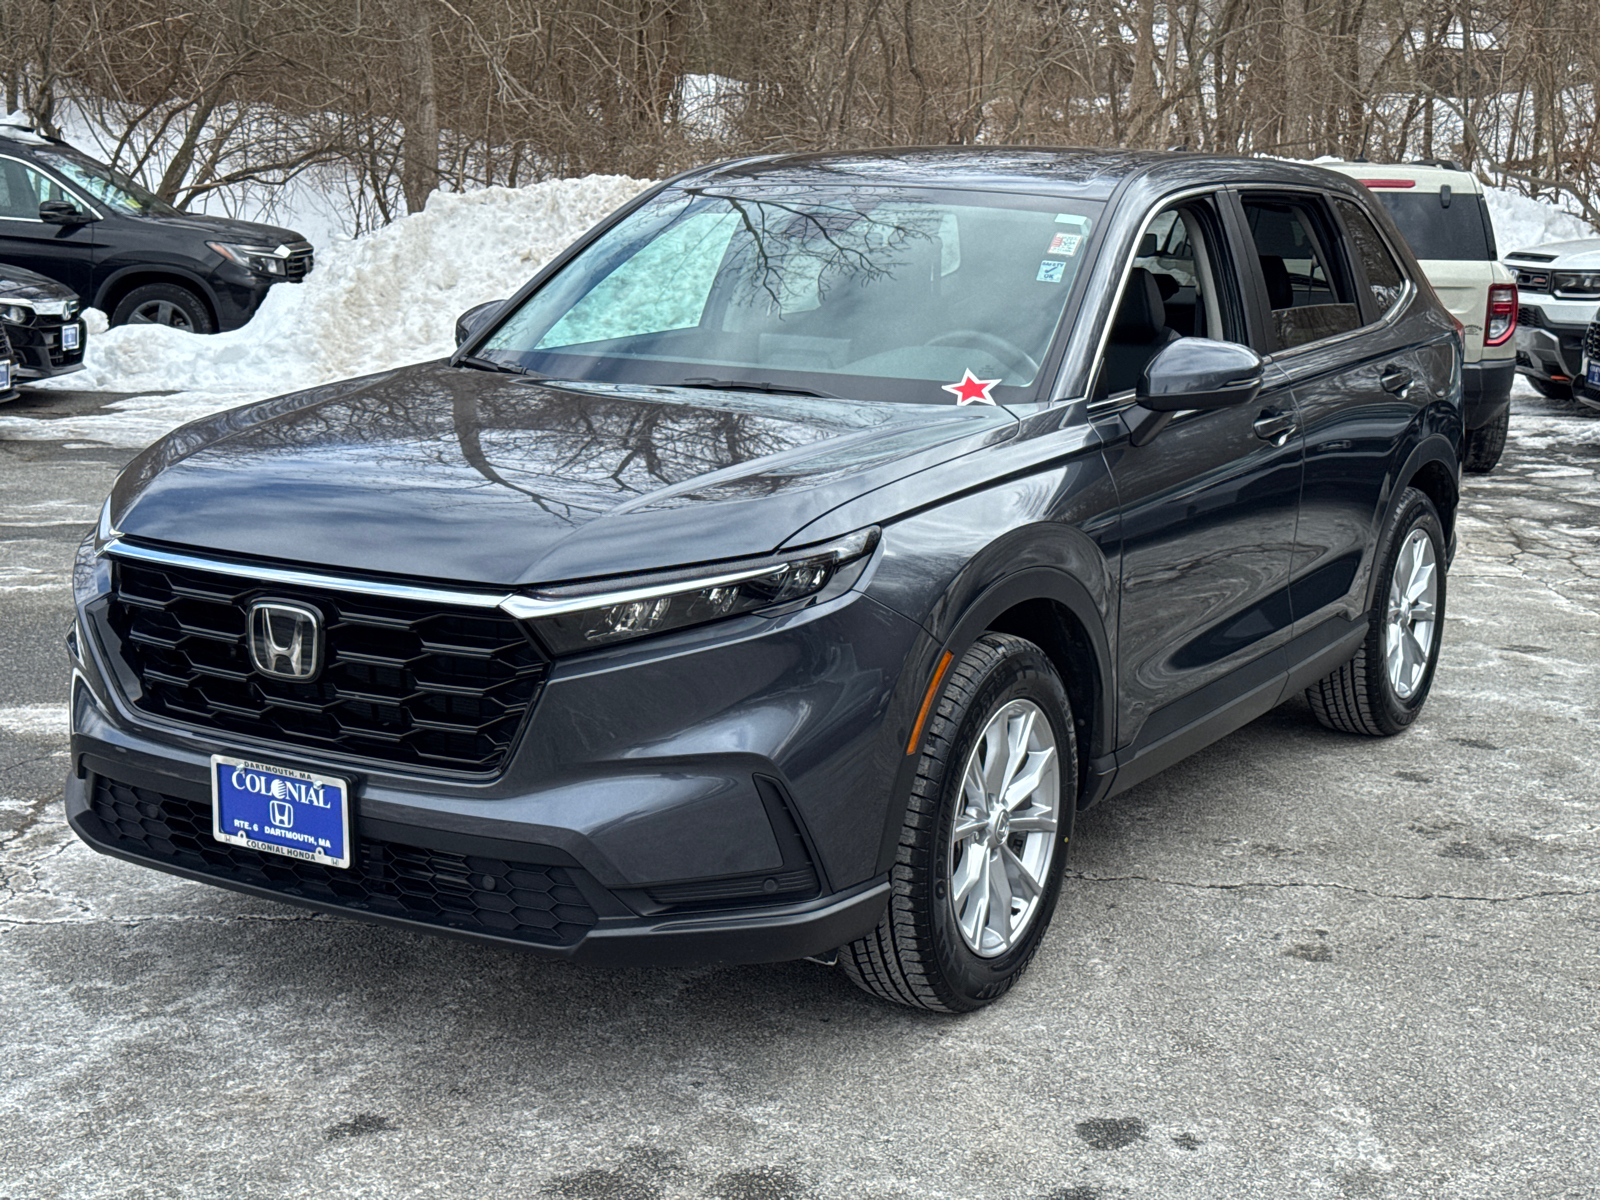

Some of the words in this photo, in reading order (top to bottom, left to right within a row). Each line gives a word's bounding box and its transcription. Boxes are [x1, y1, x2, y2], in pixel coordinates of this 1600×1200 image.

[232, 771, 331, 808] COLONIAL
[234, 819, 252, 830] RTE.
[264, 826, 317, 845] DARTMOUTH,
[318, 838, 331, 848] MA
[246, 840, 285, 854] COLONIAL
[287, 849, 315, 860] HONDA
